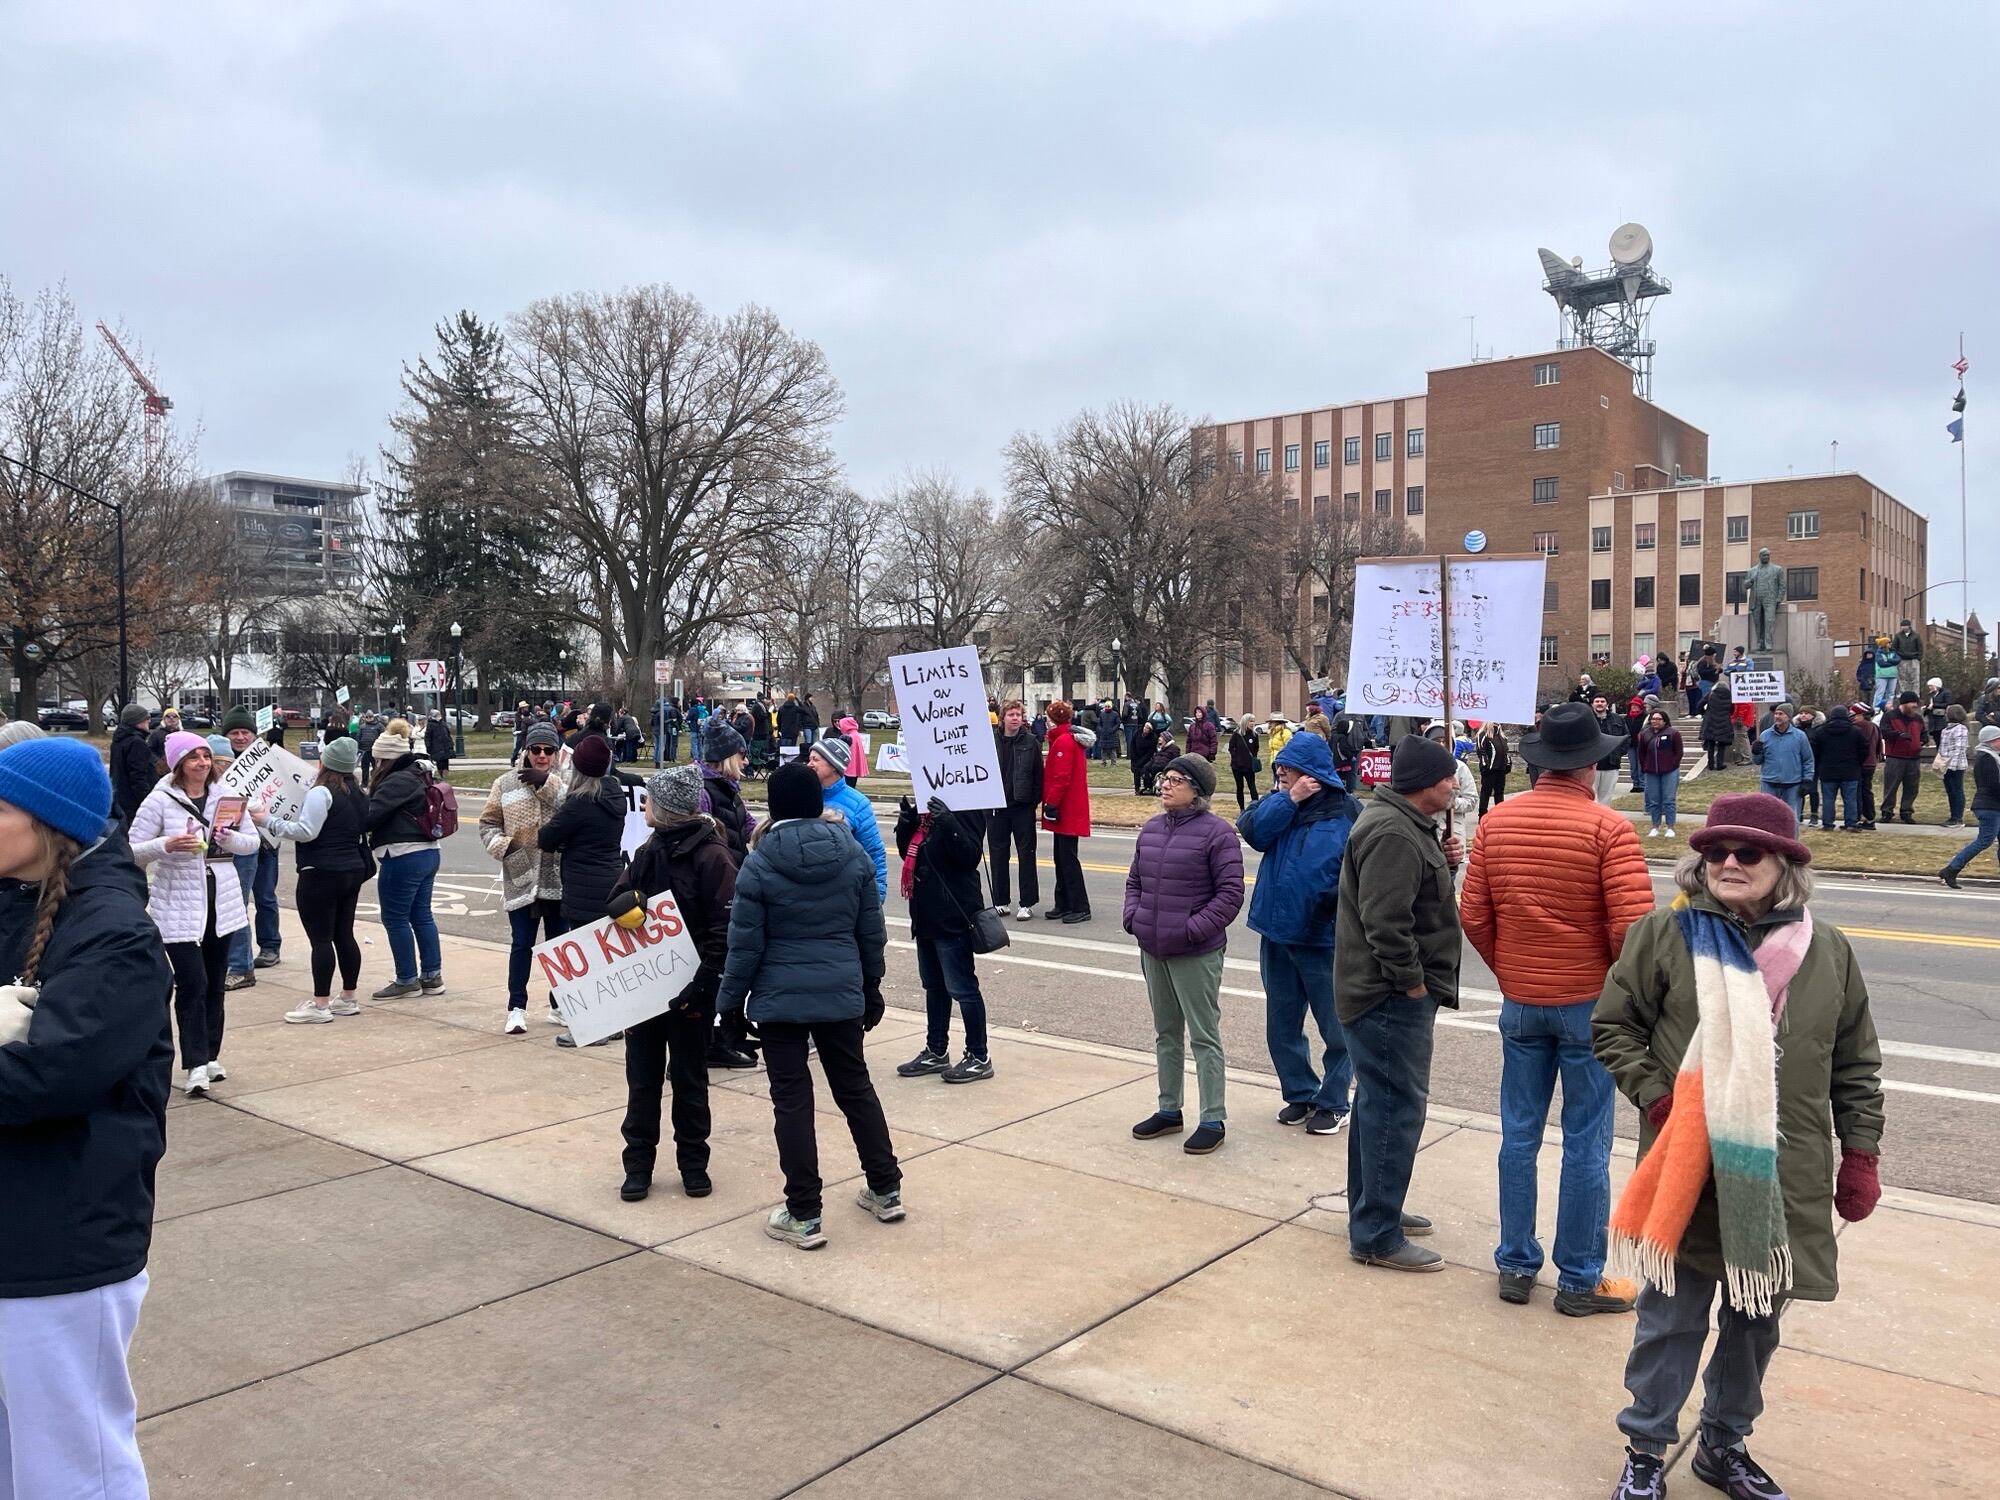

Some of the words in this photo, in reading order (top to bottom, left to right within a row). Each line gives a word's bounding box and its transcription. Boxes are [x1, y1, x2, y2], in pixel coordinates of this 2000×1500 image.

[364, 657, 382, 665] Capitol
[225, 741, 270, 788] STRONG
[944, 744, 969, 755] THE
[239, 763, 274, 798] WOMEN
[261, 777, 284, 807] ARE
[269, 794, 287, 815] eak
[537, 940, 589, 989] NO
[594, 900, 683, 965] KINGS
[561, 989, 588, 1017] IN
[596, 949, 689, 1004] AMERICA
